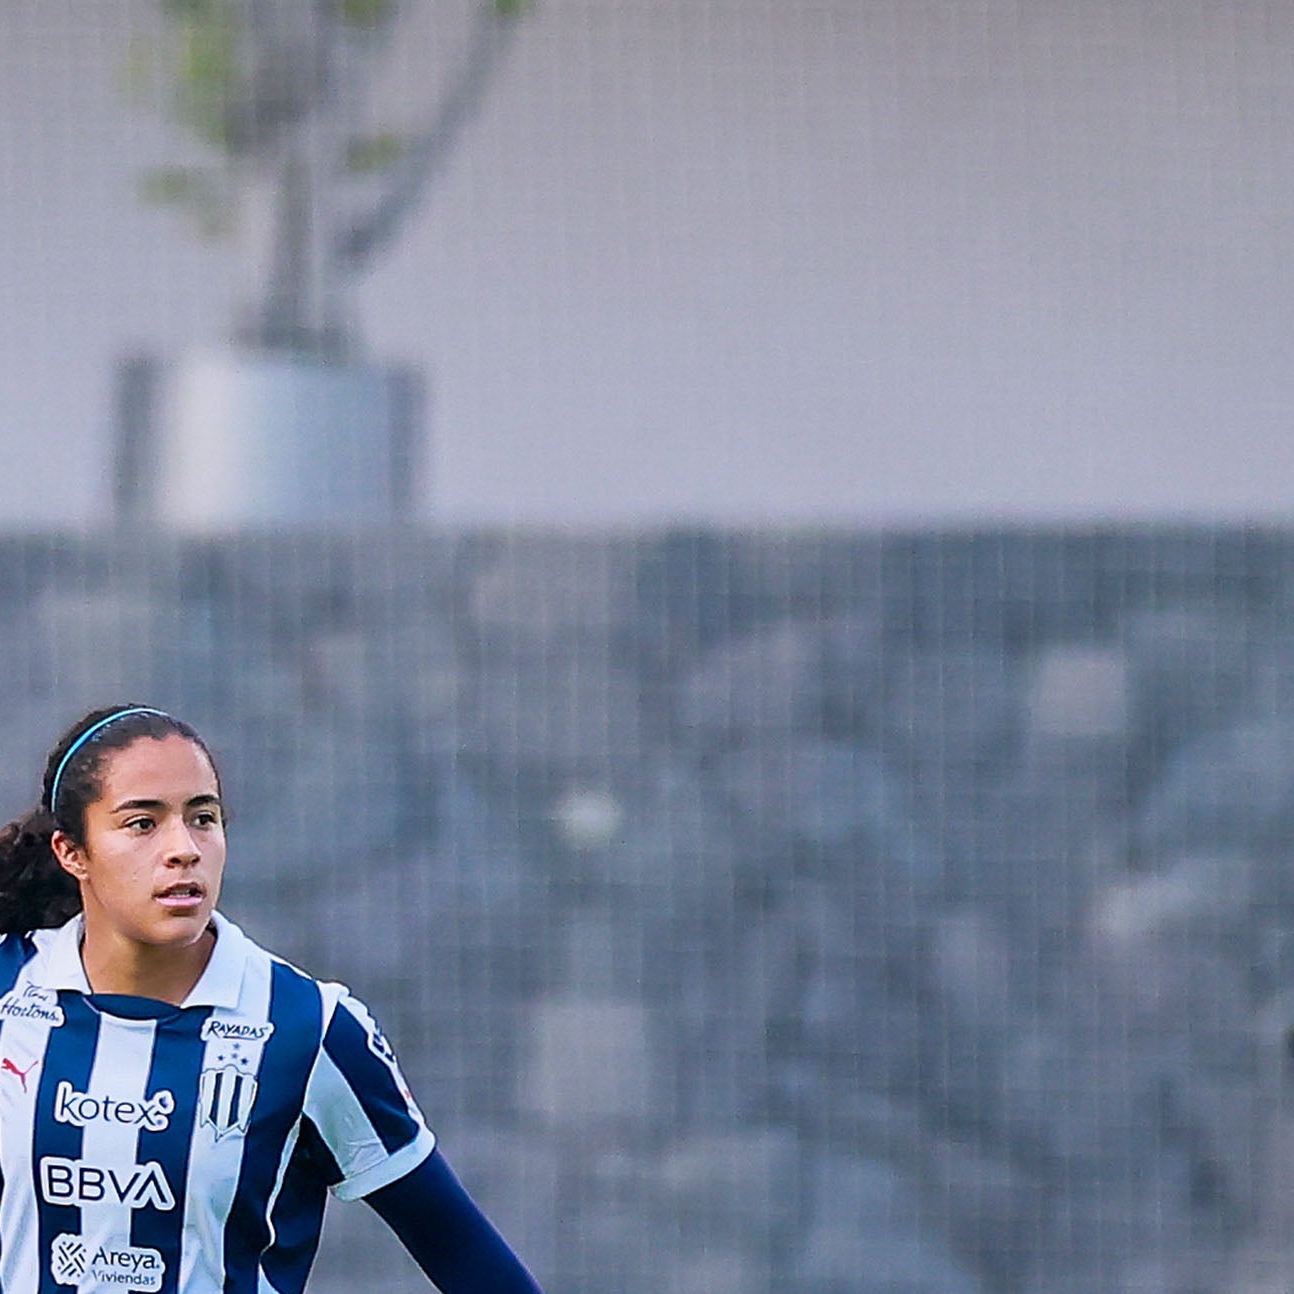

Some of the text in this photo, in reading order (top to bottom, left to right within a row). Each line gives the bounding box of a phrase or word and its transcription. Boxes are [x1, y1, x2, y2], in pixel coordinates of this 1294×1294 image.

[0, 996, 59, 1021] Hortons
[207, 1020, 268, 1040] RAYADAS
[60, 1089, 154, 1125] kotex
[47, 1168, 169, 1203] BBVA
[92, 1247, 156, 1272] Areya
[93, 1270, 157, 1286] Viviendas
